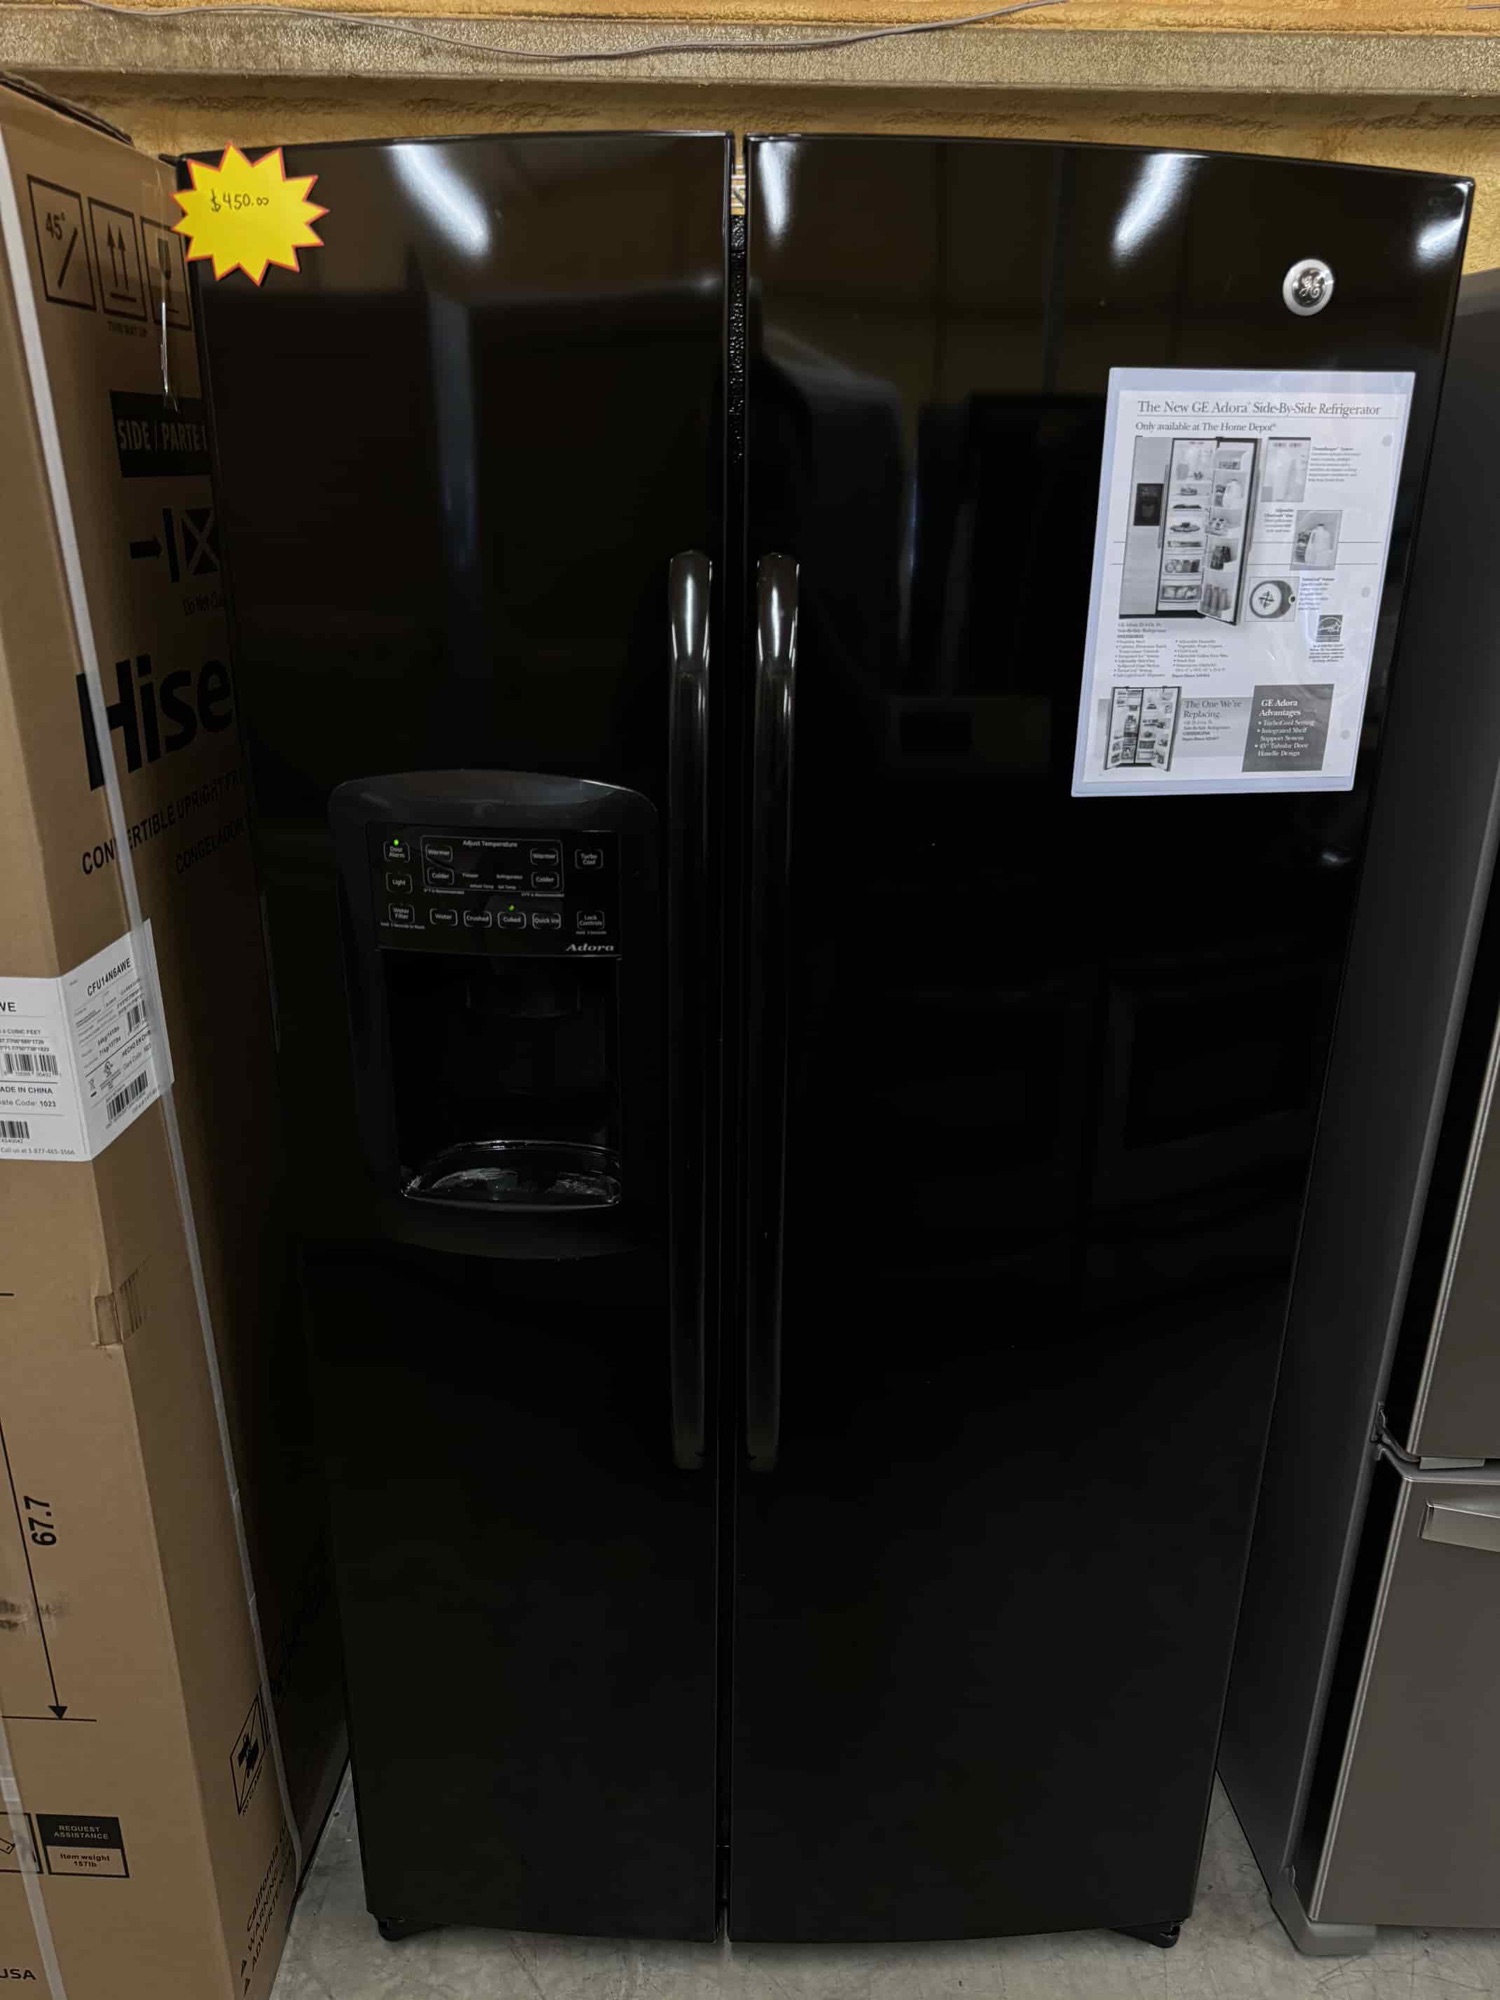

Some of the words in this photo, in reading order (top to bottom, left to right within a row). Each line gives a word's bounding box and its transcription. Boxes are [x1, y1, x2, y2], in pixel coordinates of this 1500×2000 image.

[211, 188, 270, 212] $450.00
[1138, 400, 1160, 412] The
[1164, 401, 1190, 412] New
[1192, 401, 1209, 413] GE
[1252, 401, 1317, 417] Side-By-Side
[1319, 403, 1381, 418] Refrigerator
[1135, 421, 1155, 432] Only
[1156, 422, 1190, 431] available
[1191, 423, 1200, 431] at
[1202, 422, 1218, 431] The
[1219, 422, 1246, 431] Home
[116, 418, 151, 450] SIDE
[160, 421, 199, 452] PARTE
[1185, 700, 1200, 708] The
[1201, 700, 1219, 708] One
[1220, 699, 1242, 708] We're
[1261, 699, 1274, 707] GE
[1274, 699, 1298, 707] Adora
[1259, 709, 1301, 718] Advantages
[76, 653, 233, 791] Hise
[81, 813, 175, 876] CONERTIBLE
[462, 839, 480, 848] Adjust
[481, 840, 518, 849] Temperature
[580, 852, 598, 860] Turbo
[392, 879, 406, 887] Light
[565, 942, 616, 952] Adora
[28, 1087, 53, 1095] CHINA
[23, 1495, 57, 1546] 67.7
[58, 1825, 101, 1833] REQUEST
[54, 1831, 110, 1840] ASSISTANCE
[81, 1854, 110, 1862] weight
